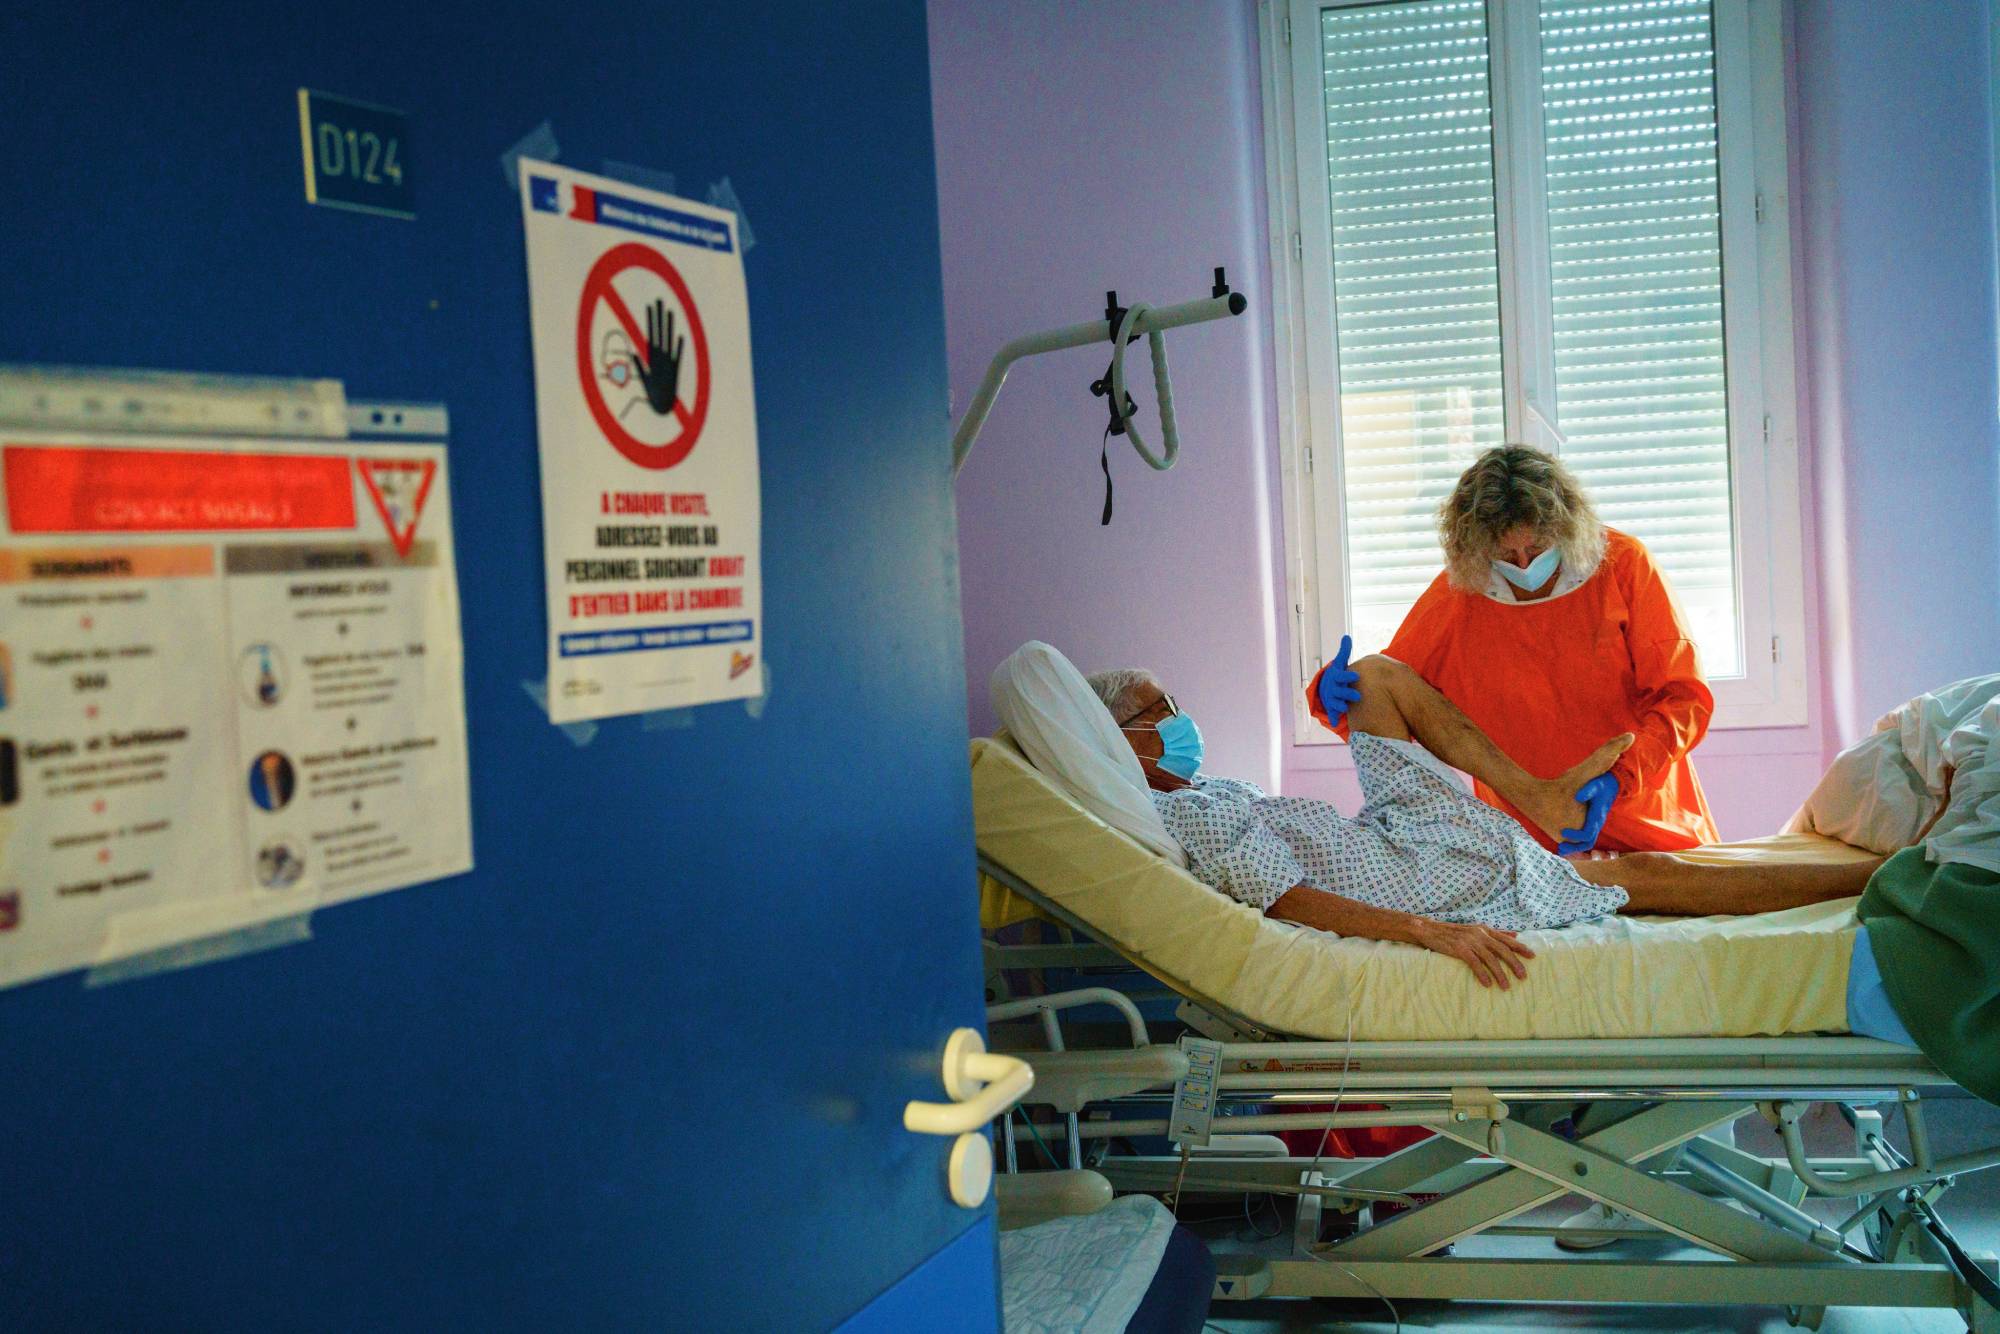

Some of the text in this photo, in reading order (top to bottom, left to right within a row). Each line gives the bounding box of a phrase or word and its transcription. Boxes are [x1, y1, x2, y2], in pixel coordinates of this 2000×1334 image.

[317, 123, 402, 186] D124
[613, 492, 666, 517] CHAQUE
[566, 559, 640, 583] PERSONNEL
[644, 557, 705, 580] SOIGNANT
[635, 590, 669, 614] DANS
[672, 588, 685, 612] LA
[689, 586, 743, 610] CHAMBRE
